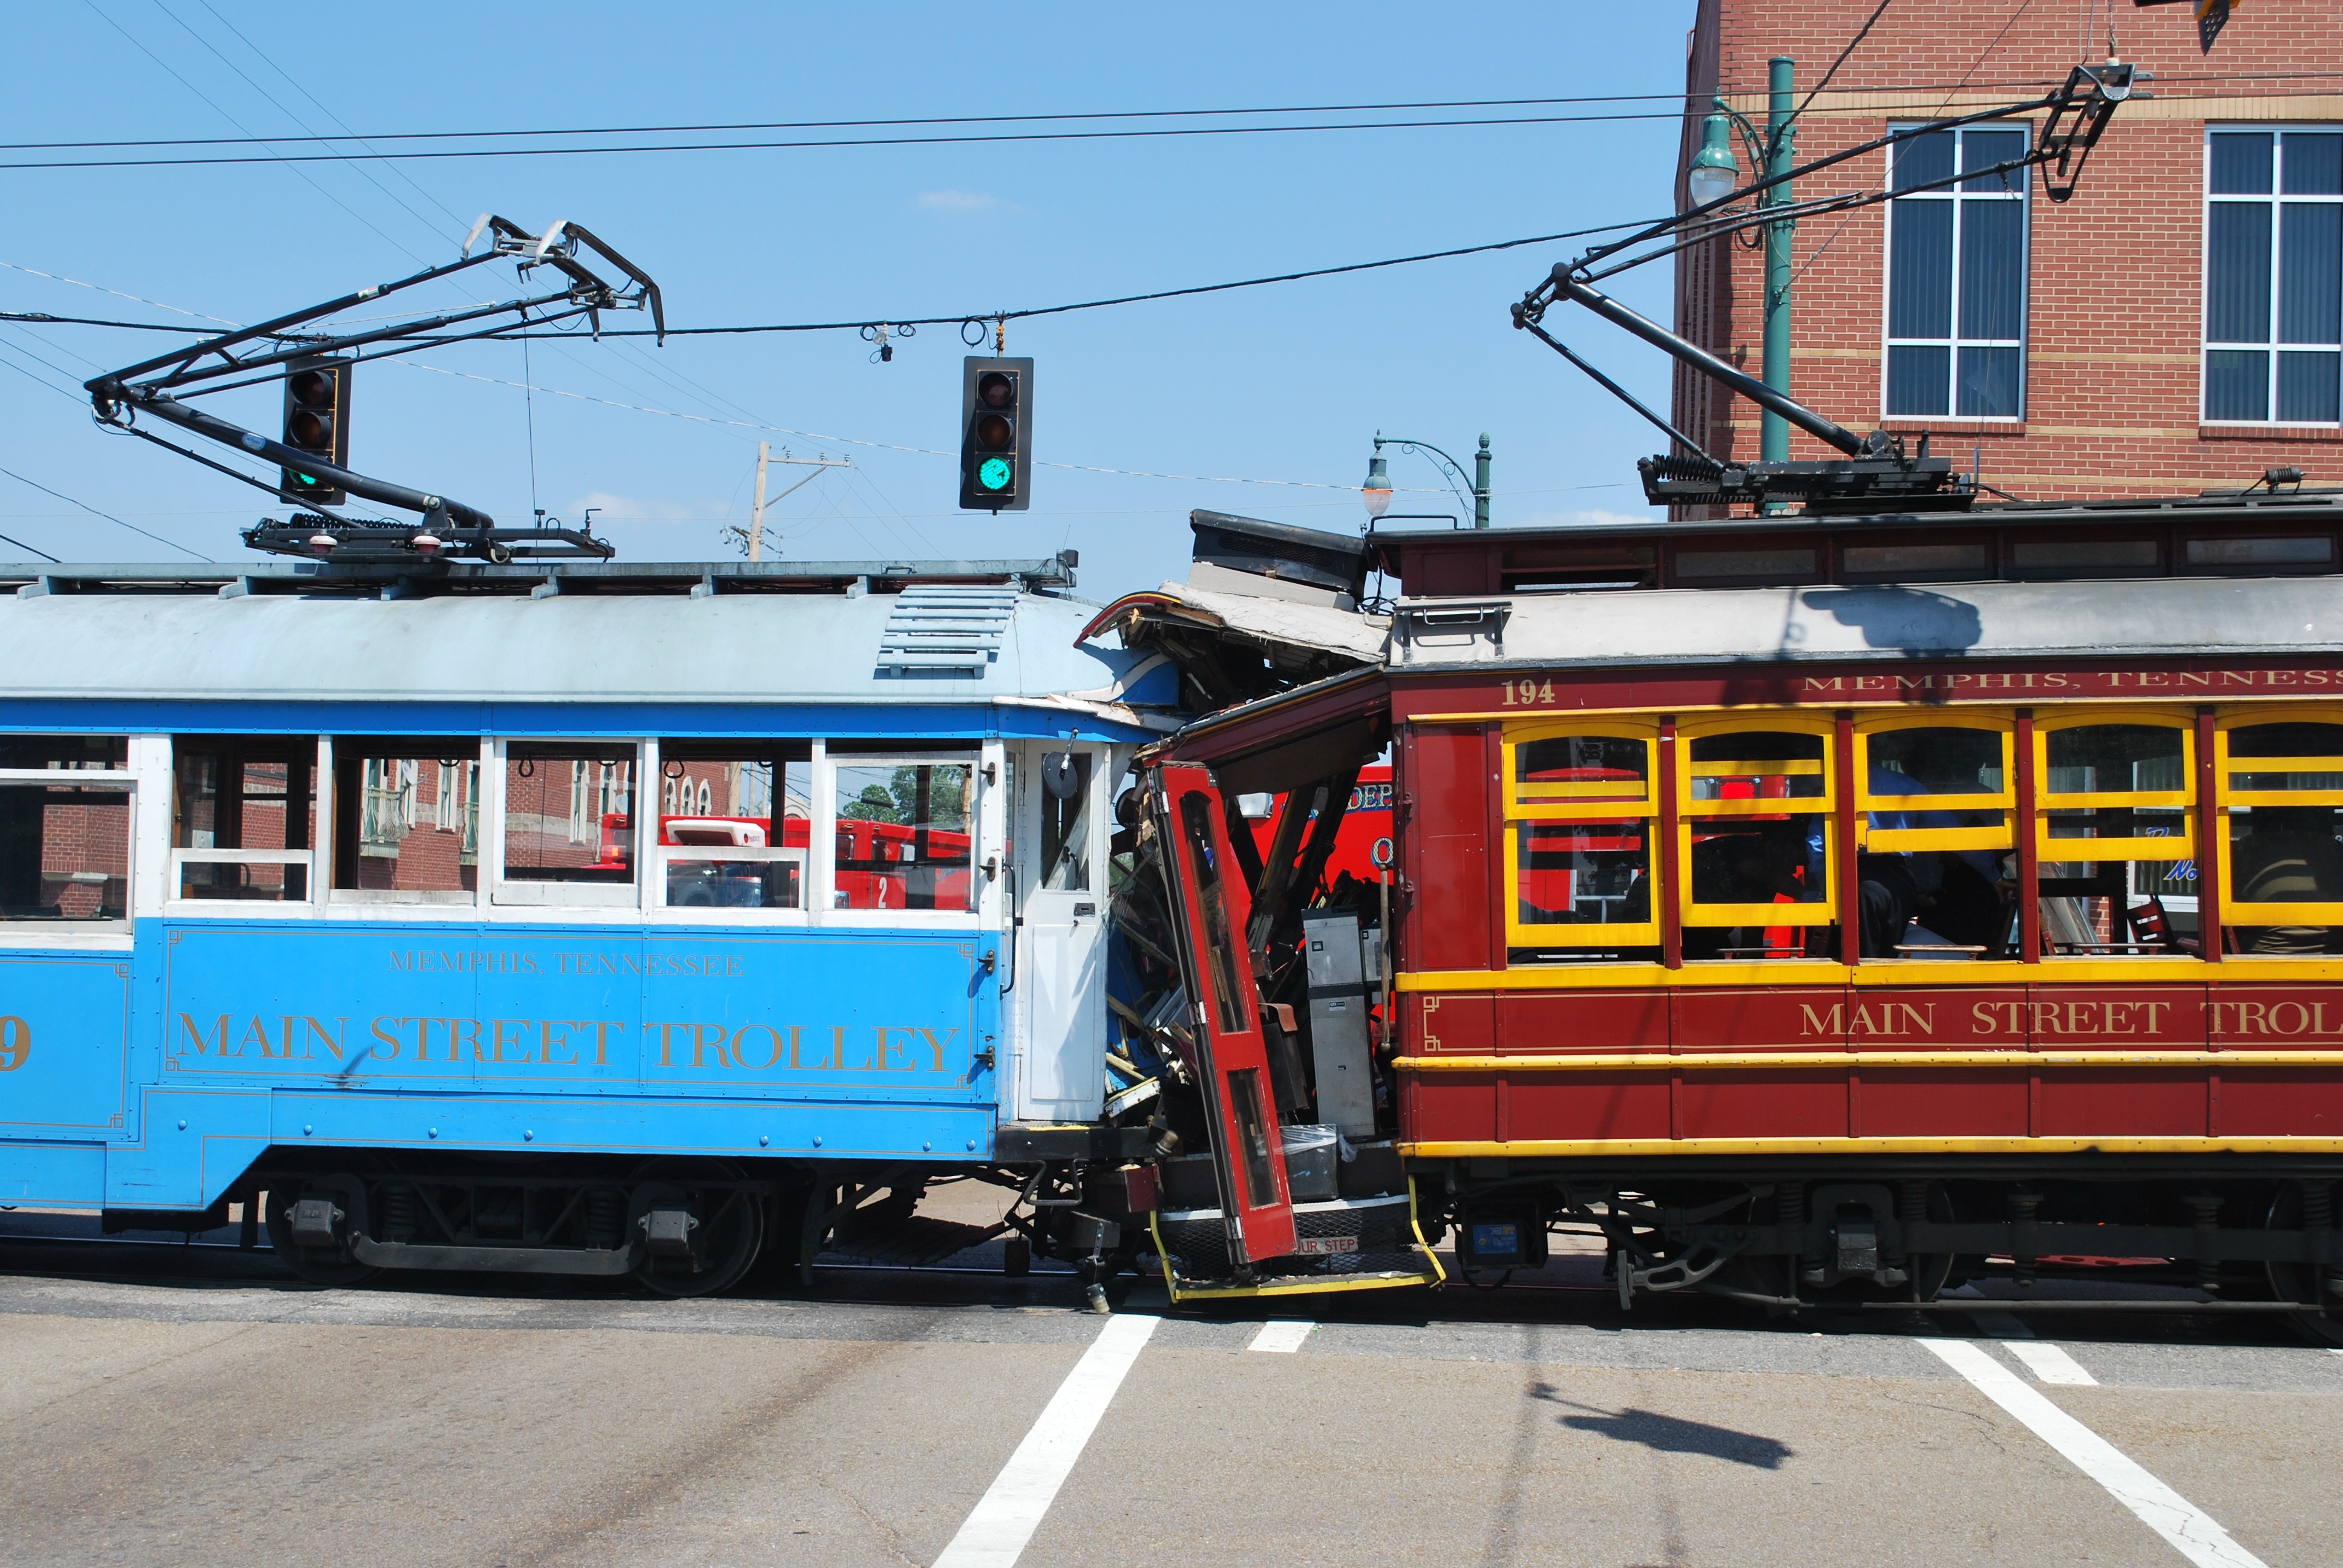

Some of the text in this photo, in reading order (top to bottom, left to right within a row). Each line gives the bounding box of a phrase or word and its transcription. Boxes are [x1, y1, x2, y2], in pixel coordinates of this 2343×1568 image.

[1501, 679, 1555, 705] 194
[1801, 673, 2081, 691] MEMPHIS,
[878, 877, 888, 909] 2
[389, 950, 744, 976] MEMPHIS, TENNESSEE
[1799, 1001, 2343, 1036] MAIN STREET TROL
[175, 1013, 961, 1072] MAIN STREET TROLLEY
[1325, 1239, 1355, 1252] STEP
